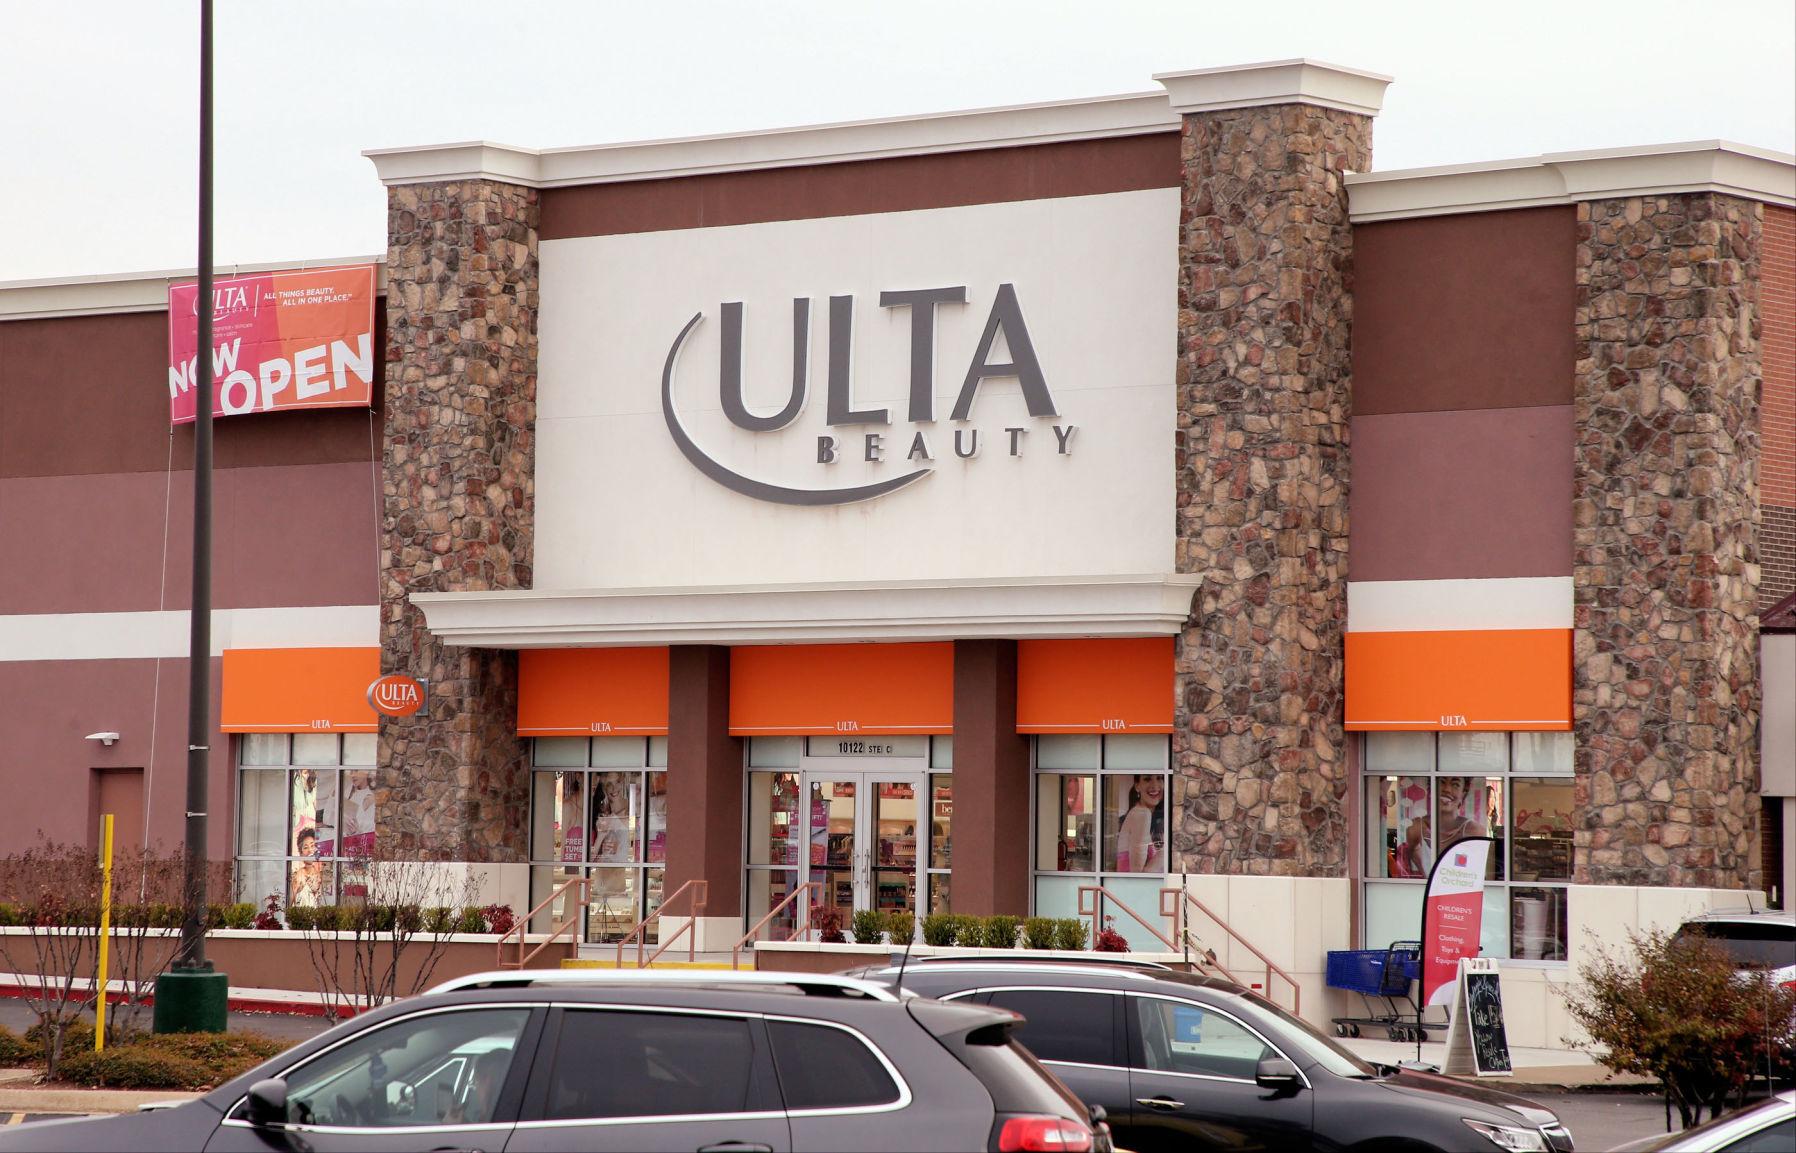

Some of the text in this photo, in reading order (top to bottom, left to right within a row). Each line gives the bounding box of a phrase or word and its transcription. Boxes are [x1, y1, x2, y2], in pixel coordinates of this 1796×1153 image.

[212, 286, 247, 310] LTA
[263, 287, 334, 300] ALL THINGS BEAUTY.
[297, 297, 306, 305] IN
[307, 296, 322, 304] ONE
[719, 283, 1062, 432] ULTA
[220, 333, 374, 416] OPEN
[816, 424, 1079, 465] BEAUTY
[381, 683, 418, 701] ULTA
[311, 719, 331, 730] ULTA
[836, 721, 858, 731] ULTA
[1102, 719, 1126, 730] ULTA
[1440, 715, 1467, 727] ULTA
[591, 722, 612, 732] ULTA
[838, 742, 863, 753] 10122
[1436, 904, 1473, 915] CHILDREN'S
[1443, 913, 1465, 921] RESALE
[1441, 945, 1454, 954] Toys
[1435, 956, 1459, 966] Equipm
